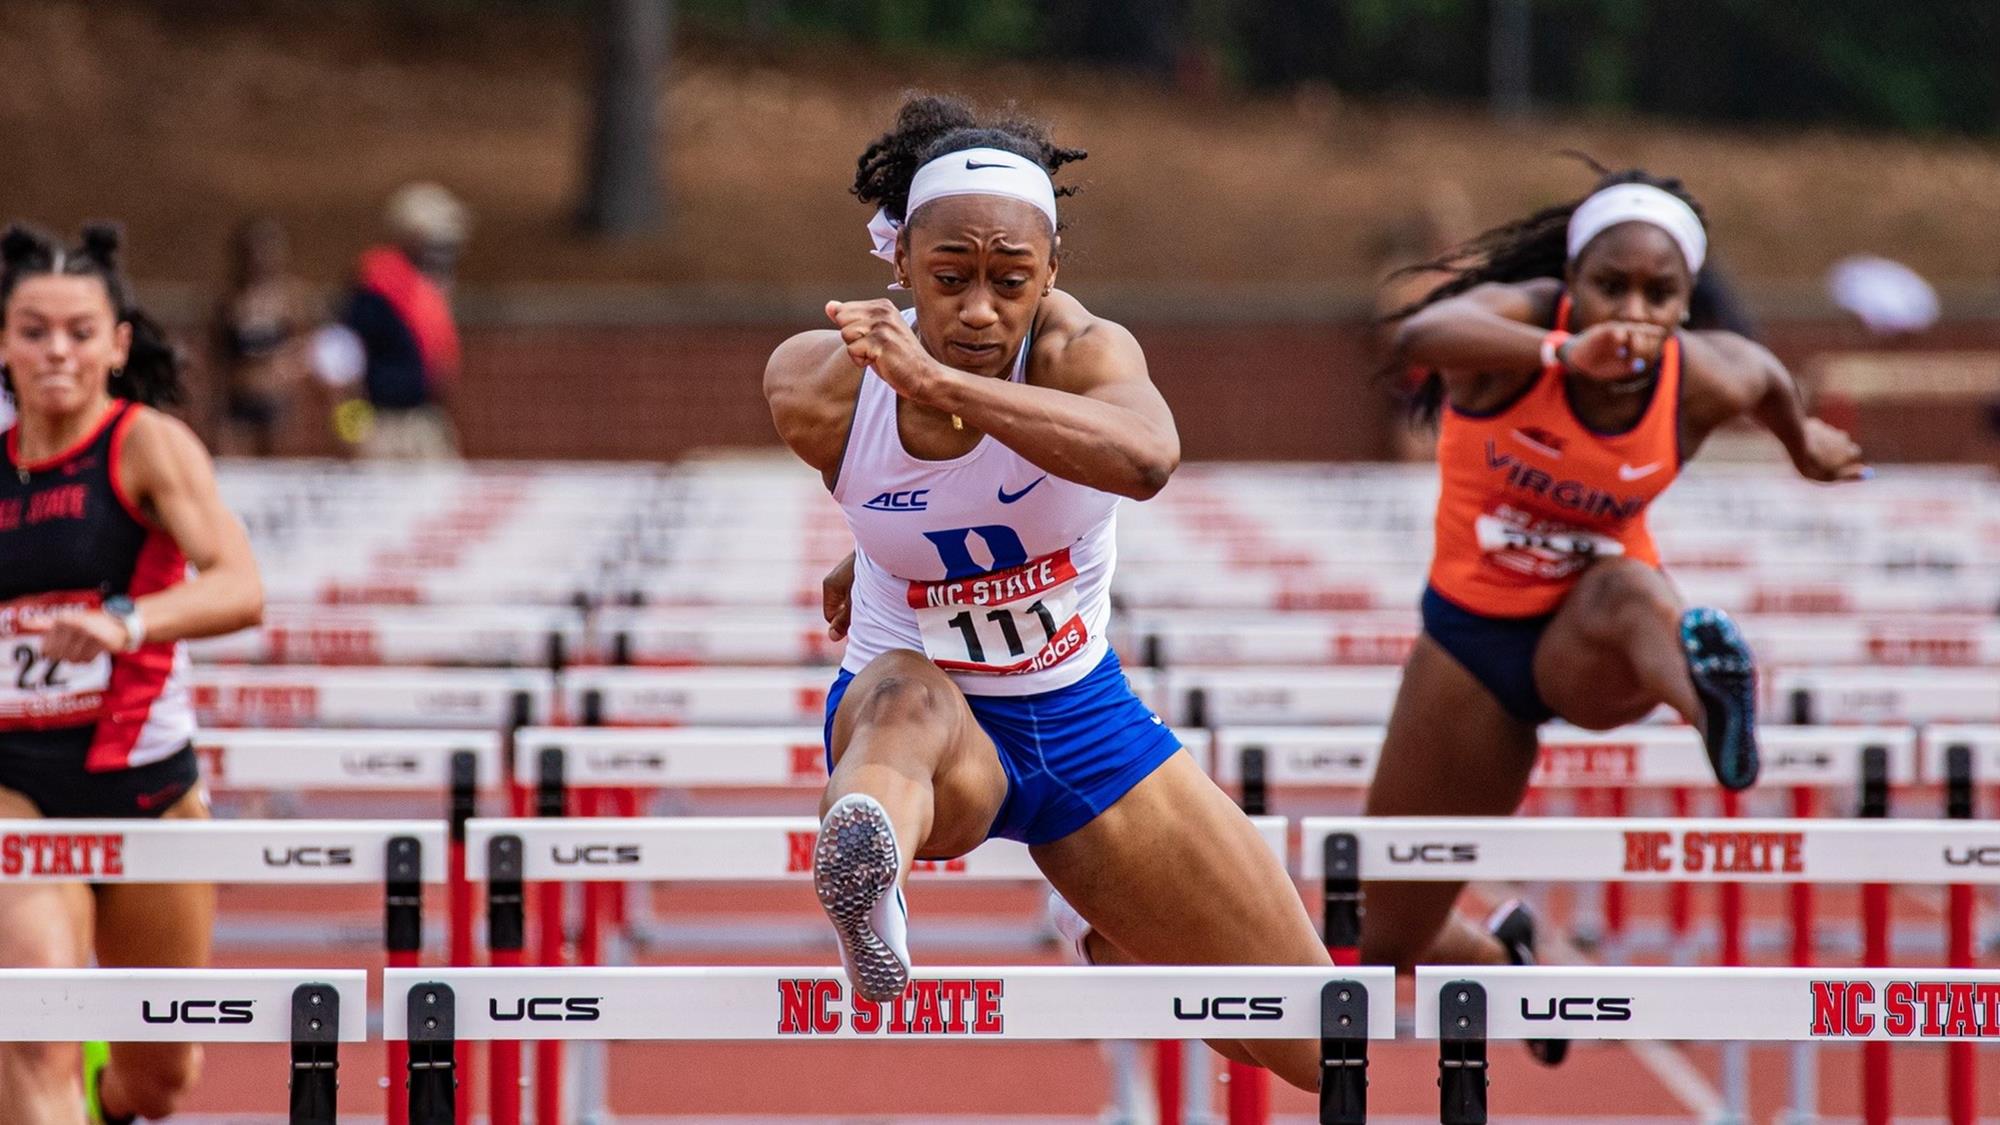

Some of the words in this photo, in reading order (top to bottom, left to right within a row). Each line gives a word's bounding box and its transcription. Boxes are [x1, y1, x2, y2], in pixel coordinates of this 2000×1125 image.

[865, 489, 930, 508] ACC
[927, 583, 964, 607] NC
[973, 559, 1055, 605] STATE
[948, 599, 1057, 663] 111
[1006, 627, 1081, 677] didas
[1, 832, 124, 875] STATE
[263, 845, 355, 868] UCS
[551, 844, 641, 866] UCS
[1387, 842, 1479, 864] UCS
[1623, 832, 1672, 873] NC
[1683, 832, 1806, 873] STATE
[142, 1000, 254, 1024] UCS
[489, 997, 601, 1021] UCS
[778, 979, 843, 1034] NC
[850, 979, 1004, 1034] STATE
[1173, 997, 1285, 1021] UCS
[1520, 997, 1632, 1021] UCS
[1810, 981, 1876, 1036] NC
[1884, 981, 2000, 1037] STAT
